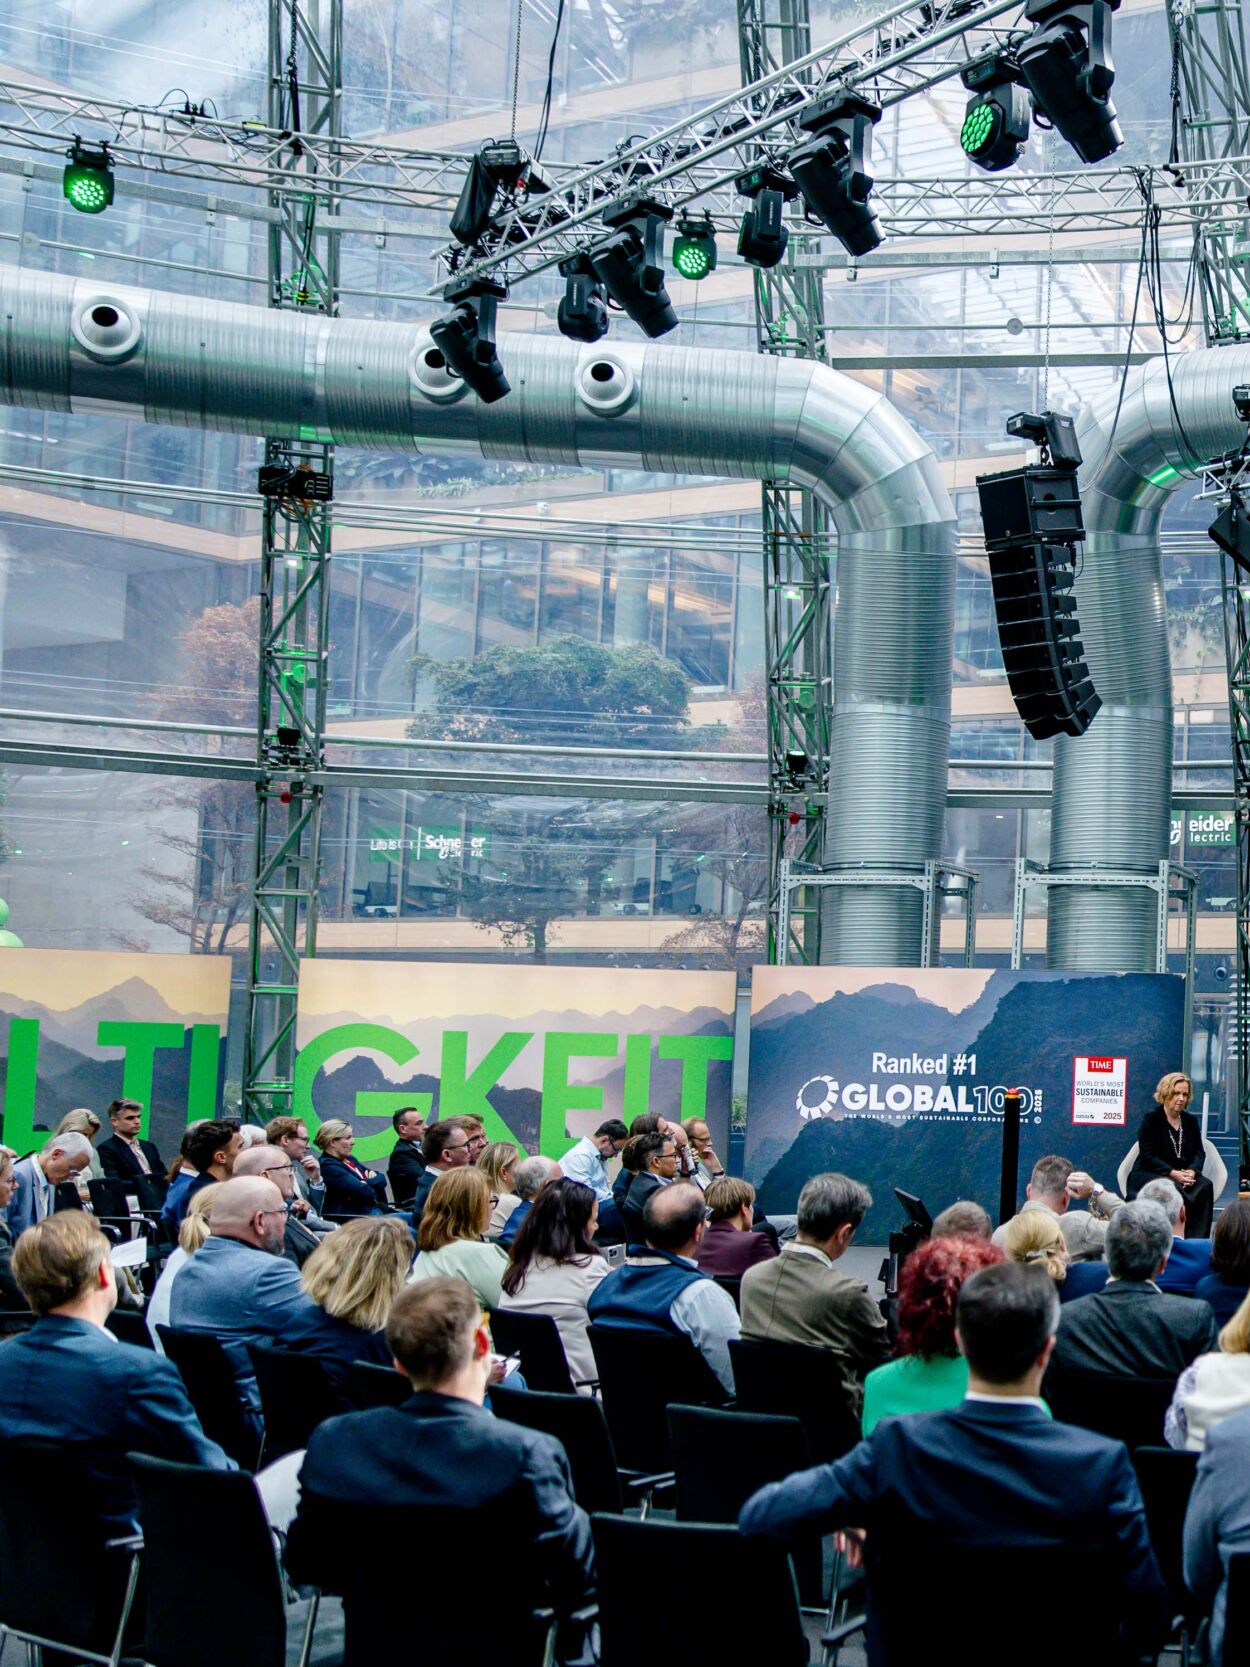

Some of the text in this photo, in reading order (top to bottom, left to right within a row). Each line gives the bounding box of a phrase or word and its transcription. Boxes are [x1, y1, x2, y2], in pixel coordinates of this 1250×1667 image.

[425, 834, 486, 850] Schneer
[1190, 832, 1232, 843] lectric
[872, 1052, 977, 1076] Ranked #1
[1090, 1060, 1112, 1069] TIME
[1075, 1087, 1124, 1097] SUSTAINABLE
[1103, 1112, 1122, 1120] 2025
